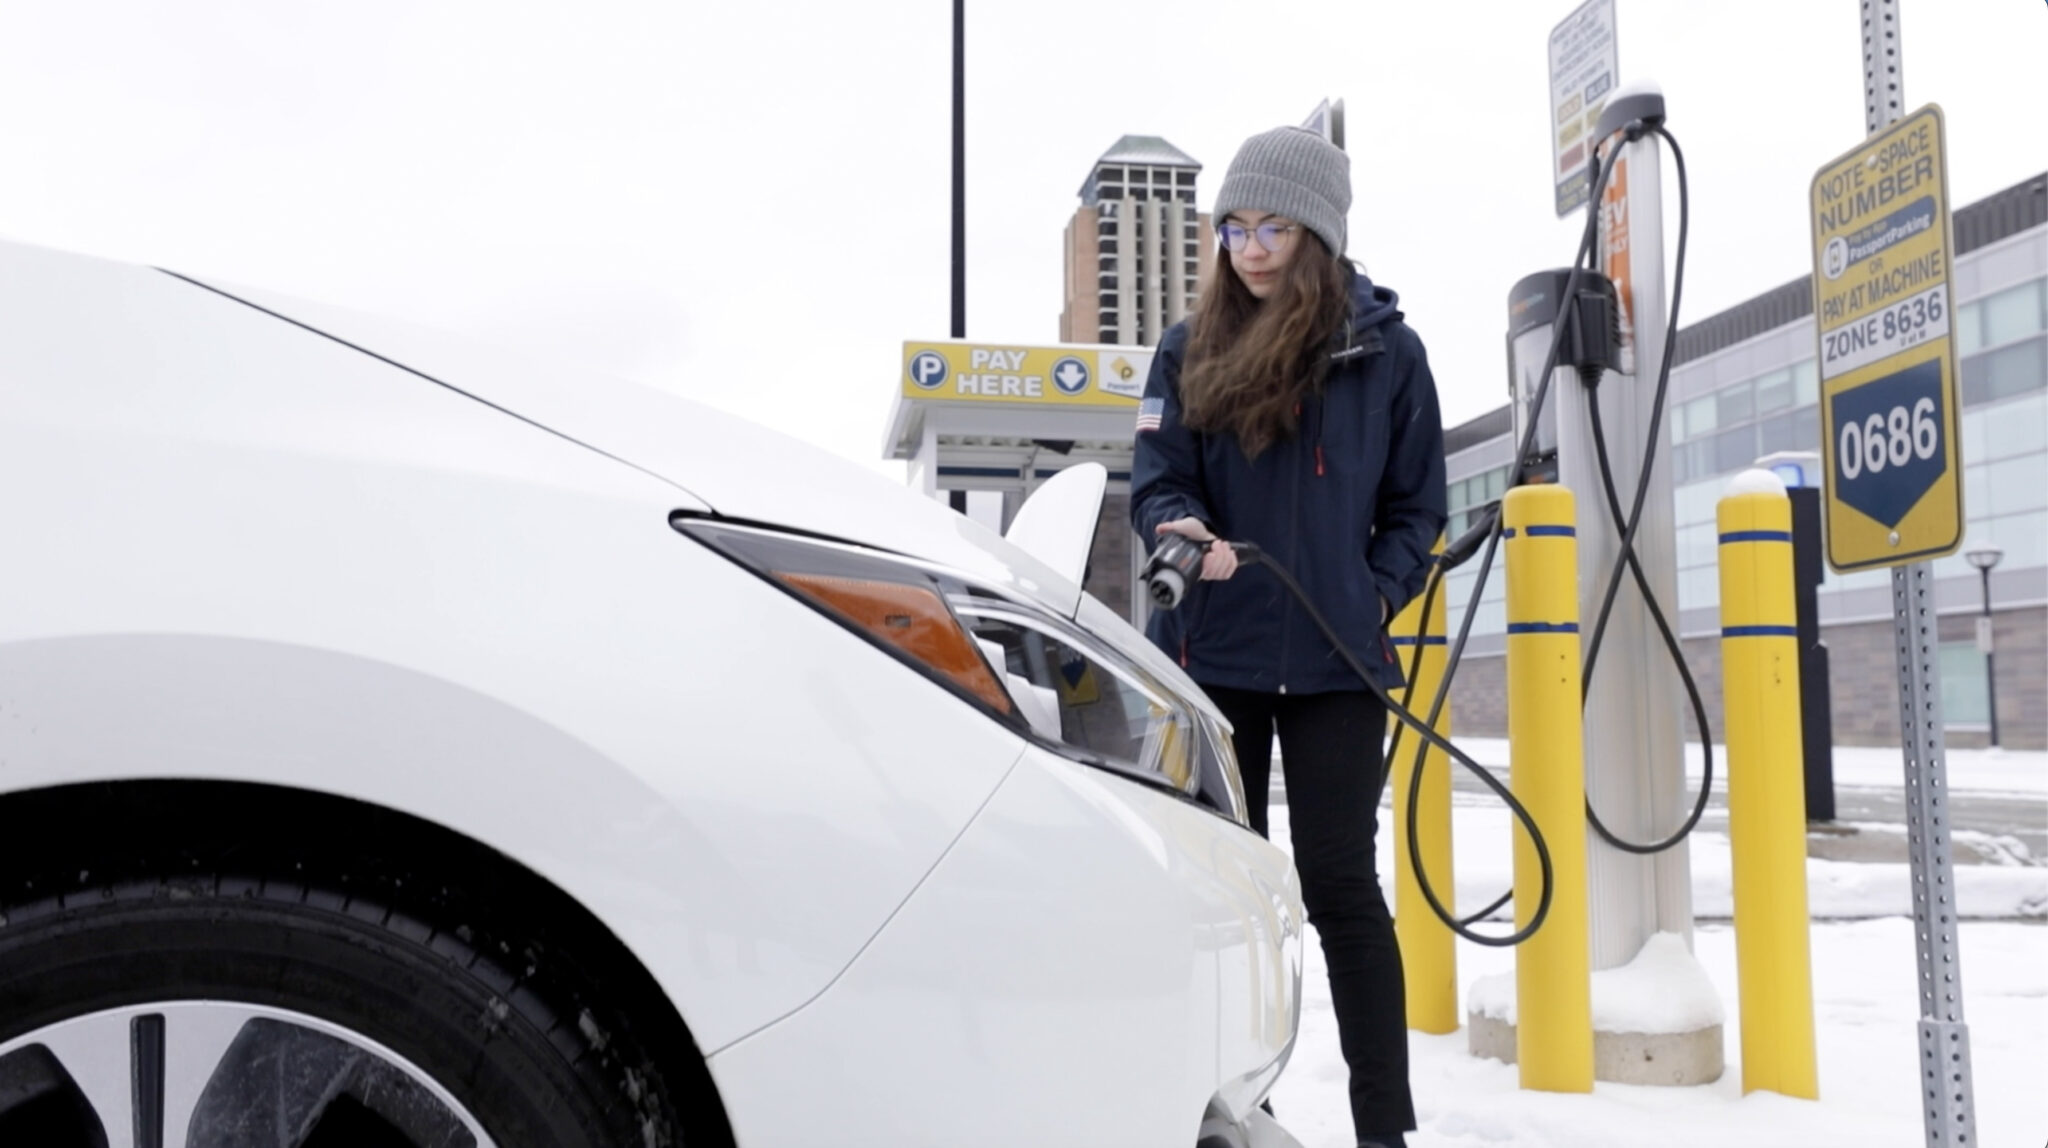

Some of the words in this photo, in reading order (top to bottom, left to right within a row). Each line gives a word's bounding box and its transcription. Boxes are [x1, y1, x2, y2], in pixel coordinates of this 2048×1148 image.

[1821, 162, 1864, 206] NOTE
[1880, 124, 1930, 173] SPACE
[1821, 155, 1933, 236] NUMBER
[1850, 214, 1930, 260] PassportParking
[1869, 257, 1883, 275] OR
[1824, 291, 1846, 323] PAY
[1850, 284, 1865, 313] AT
[1868, 249, 1941, 305] MACHINE
[1826, 318, 1878, 362] ZONE
[1883, 291, 1942, 340] 8636
[919, 356, 942, 384] P
[957, 373, 1042, 397] HERE
[971, 349, 1027, 371] PAY
[1840, 397, 1938, 480] 0686
